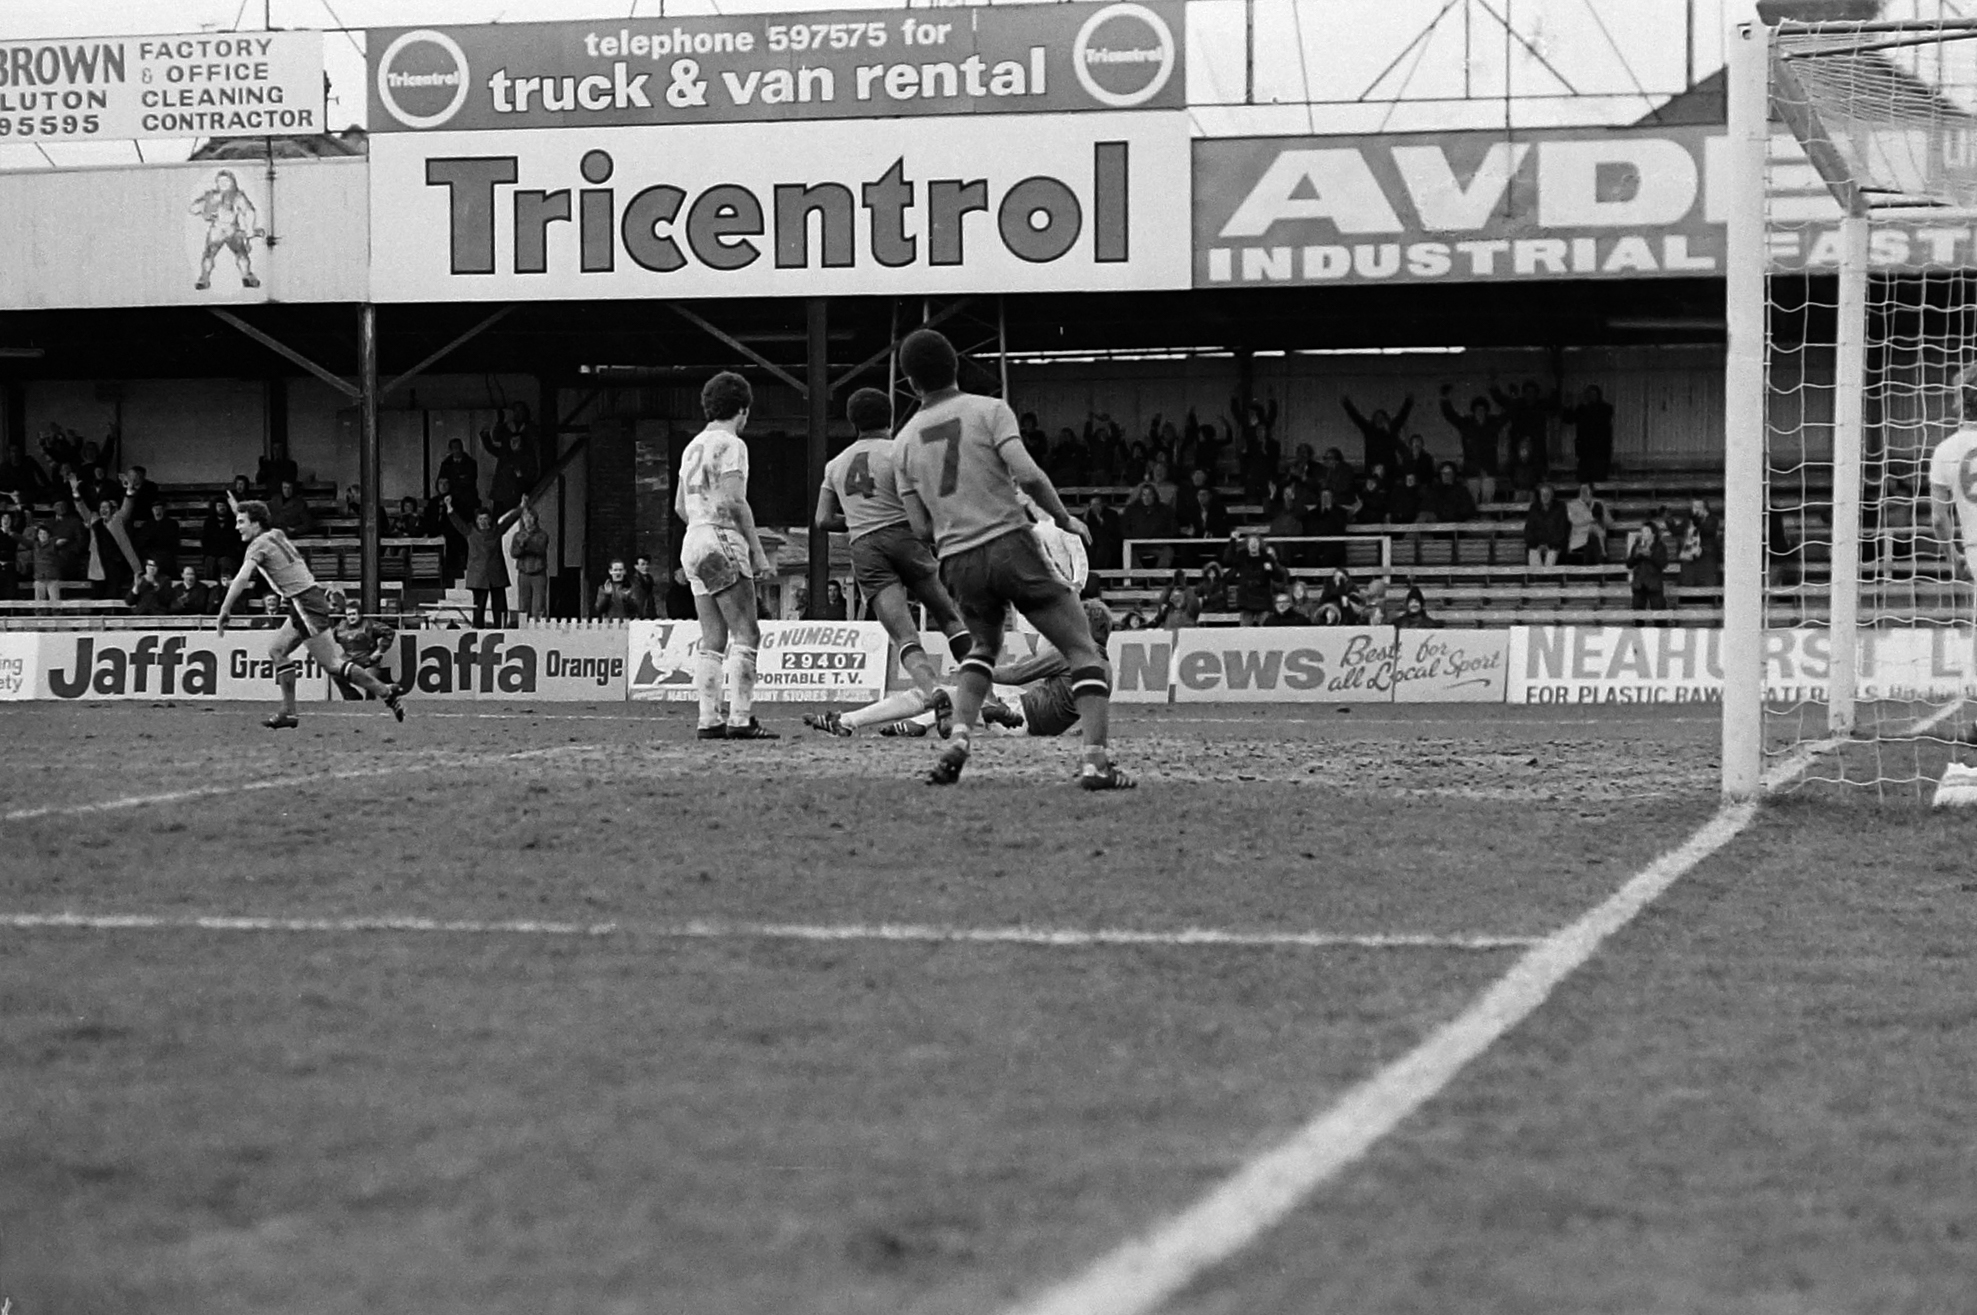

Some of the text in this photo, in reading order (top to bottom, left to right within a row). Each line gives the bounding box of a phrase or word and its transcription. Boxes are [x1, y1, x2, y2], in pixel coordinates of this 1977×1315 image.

[140, 38, 272, 61] FACTORY
[585, 18, 951, 60] telephone 597575 for
[1086, 46, 1162, 64] Tricentrol
[166, 62, 269, 83] OFFICE
[388, 70, 459, 88] Tricentrol
[488, 46, 1046, 113] truck & van rental
[0, 89, 107, 112] LUTON
[141, 86, 284, 109] CLEANING
[141, 110, 314, 131] CONTRACTOR
[425, 141, 1129, 275] Tricentrol
[1208, 235, 1716, 282] INDUSTRIAL
[919, 417, 963, 498] 7
[844, 451, 876, 499] 4
[777, 627, 860, 647] NUMBER
[1340, 634, 1447, 668] Best for
[48, 635, 217, 698] Jaffa
[386, 632, 623, 696] Jaffa Orange
[784, 654, 865, 668] 29407
[1117, 642, 1326, 690] News
[1328, 648, 1500, 692] all Local Sport
[755, 672, 826, 684] PORTABLE
[1526, 686, 1569, 703] FOR
[1578, 686, 1668, 703] PLASTIC
[1675, 686, 1724, 703] RAW
